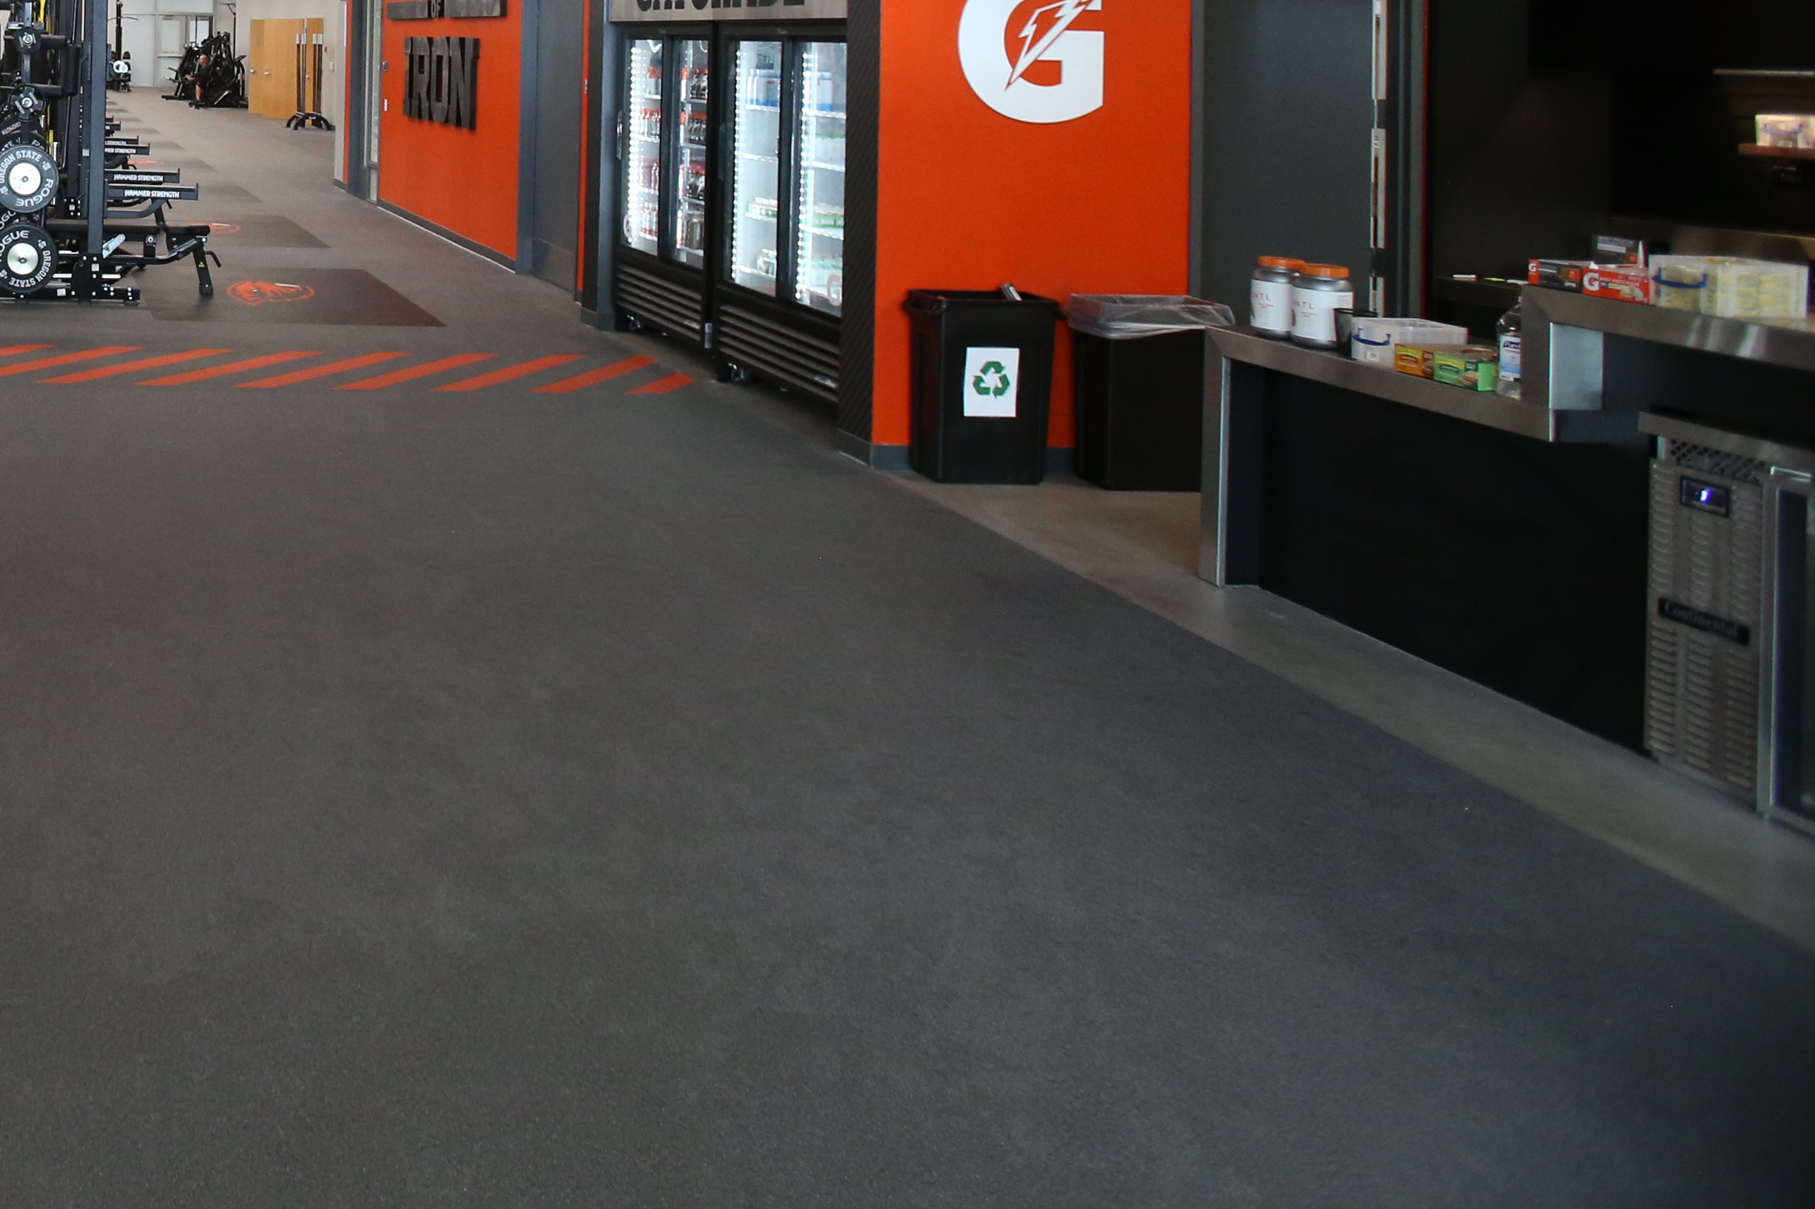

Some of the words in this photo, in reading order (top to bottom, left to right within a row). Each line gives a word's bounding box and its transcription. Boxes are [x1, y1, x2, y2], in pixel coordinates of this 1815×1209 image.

[403, 36, 480, 131] IRON
[16, 150, 42, 162] STATE
[15, 178, 54, 207] ROGUE
[35, 250, 51, 282] OREGON
[9, 277, 36, 287] STATE
[1583, 272, 1599, 291] G
